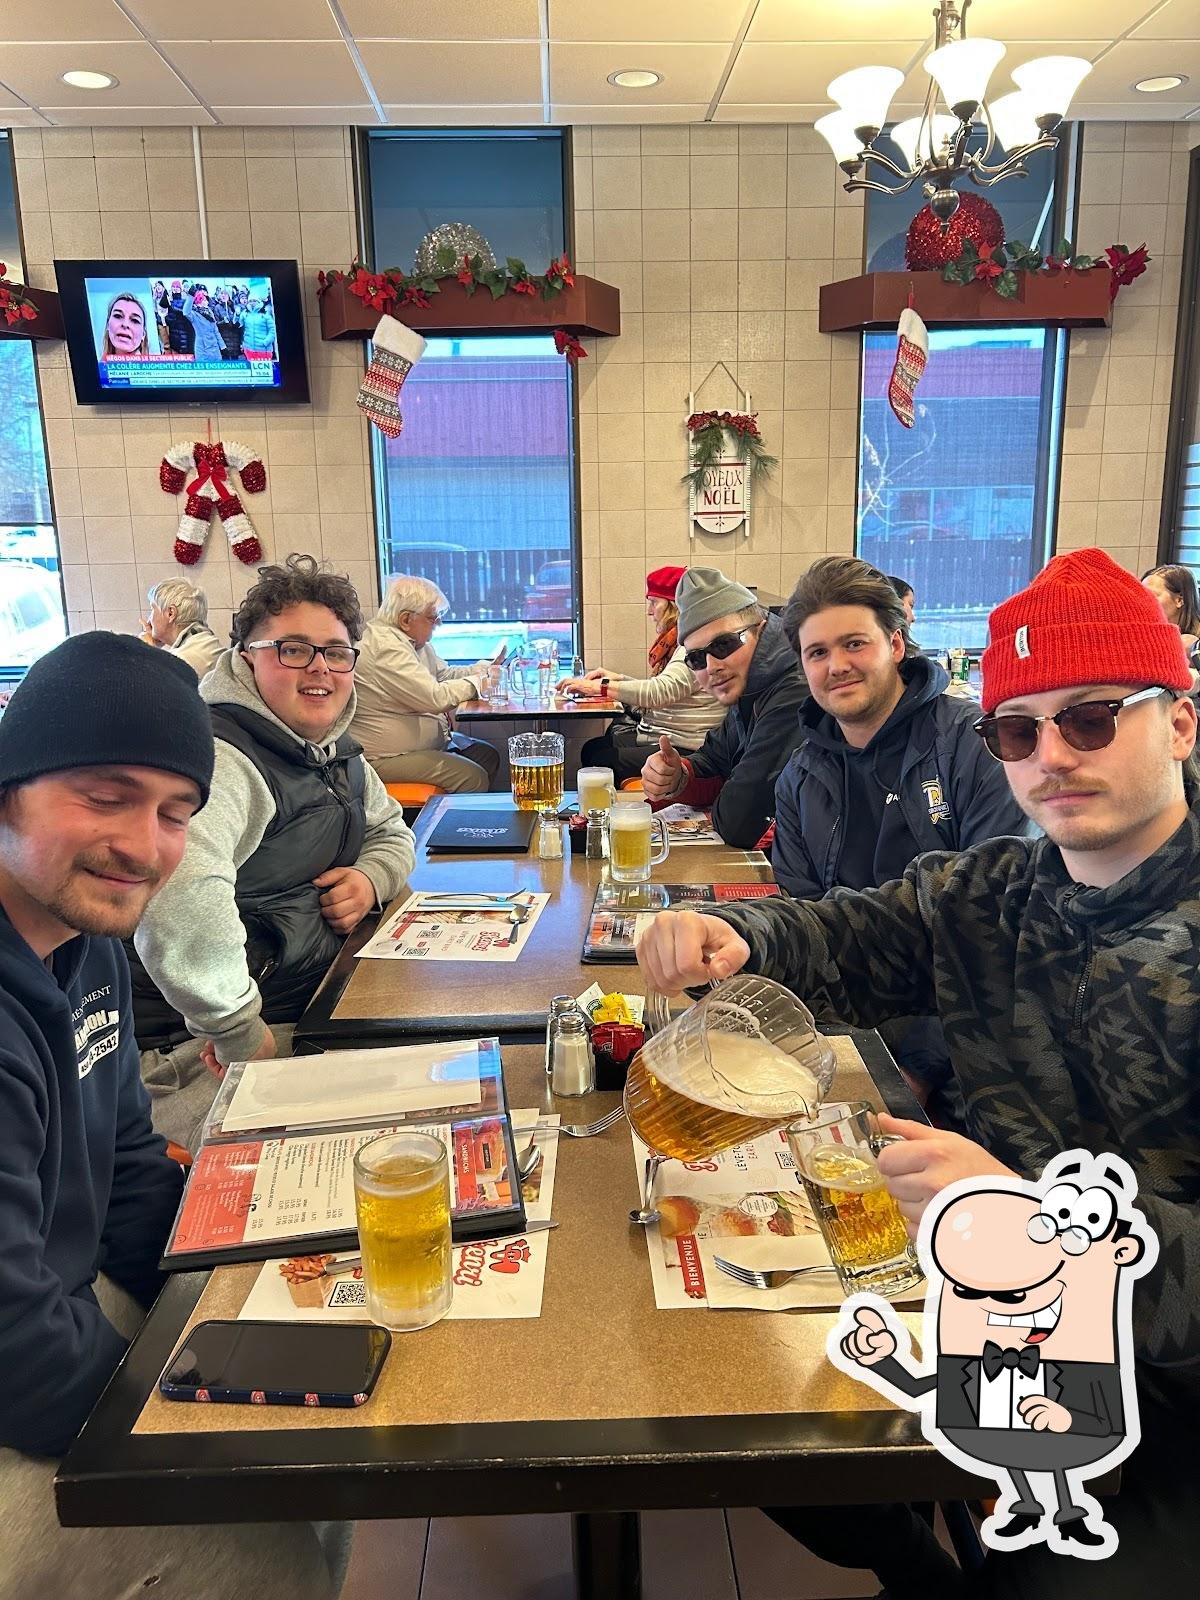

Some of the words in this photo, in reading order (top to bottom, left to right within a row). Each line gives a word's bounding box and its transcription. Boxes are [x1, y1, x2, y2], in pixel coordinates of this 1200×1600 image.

[702, 470, 742, 487] OYEUX
[704, 487, 741, 506] NOËL
[453, 1241, 493, 1286] enri
[682, 1240, 700, 1286] BIENVENUE
